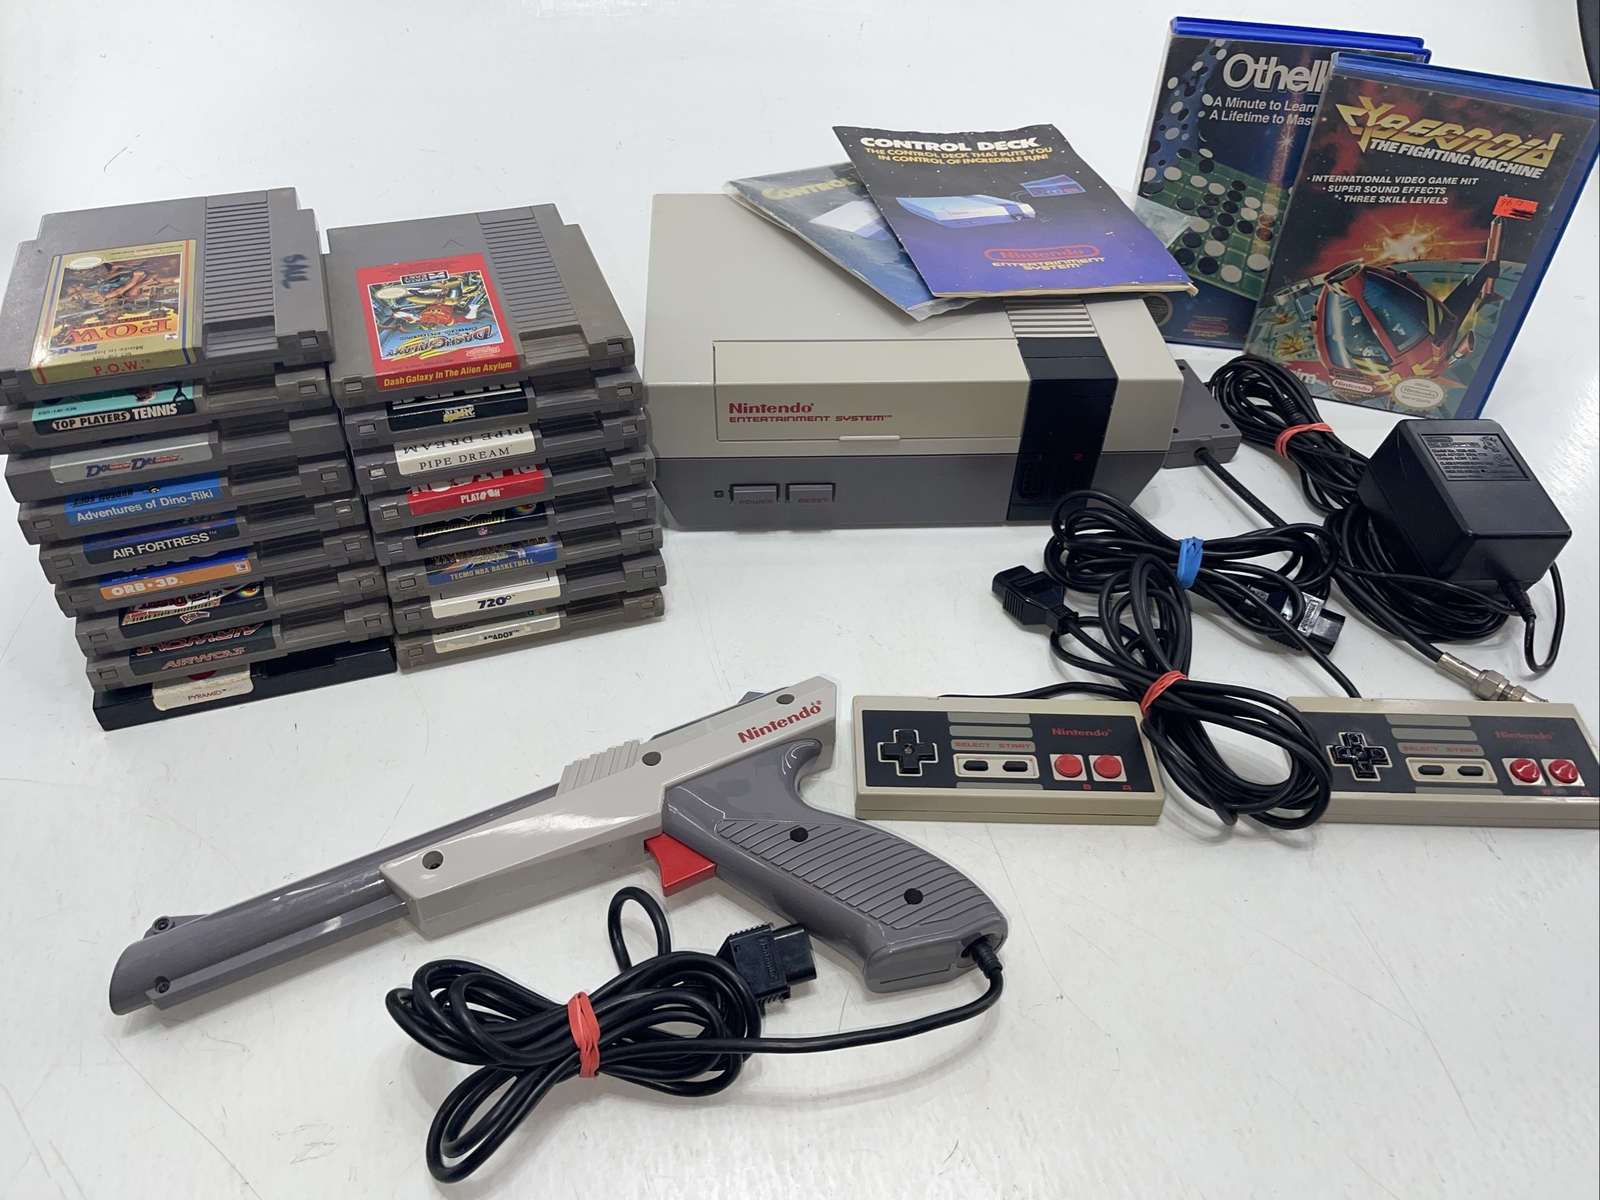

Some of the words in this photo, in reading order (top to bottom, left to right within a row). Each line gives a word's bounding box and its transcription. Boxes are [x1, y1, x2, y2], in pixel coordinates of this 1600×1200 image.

[1222, 53, 1329, 93] Othell
[1212, 96, 1222, 107] A
[1225, 97, 1266, 109] Minute
[1269, 101, 1282, 111] to
[1209, 110, 1218, 121] A
[1221, 110, 1269, 123] Lifetime
[1272, 114, 1284, 125] to
[1286, 113, 1314, 126] Mas
[860, 137, 972, 152] CONTROL
[977, 137, 1040, 151] DECK
[864, 147, 886, 156] THE
[887, 148, 940, 158] CONTROL
[1000, 149, 1027, 158] PUTS
[1028, 146, 1053, 155] YOU
[877, 154, 891, 162] IN
[892, 155, 946, 165] CONTROL
[962, 156, 1023, 164] INCREDIBLE
[1023, 153, 1049, 162] FUN!
[1369, 138, 1400, 154] THE
[1398, 142, 1471, 167] FIGHTING
[1470, 156, 1545, 180] MACHINE
[1311, 174, 1392, 184] INTERNATIONAL
[1395, 176, 1426, 185] VIDEO
[1428, 176, 1458, 185] GAME
[1461, 177, 1479, 186] HIT
[761, 178, 857, 200] CONTROL
[1327, 185, 1362, 193] SUPER
[1364, 185, 1400, 194] SOUND
[1401, 186, 1447, 195] EFFECTS
[1343, 195, 1377, 203] THREE
[1378, 195, 1408, 204] SKILL
[1409, 196, 1449, 205] LEVELS
[1000, 248, 1084, 260] Nintendo
[992, 257, 1105, 268] ENTERTAINMENT
[1023, 263, 1080, 271] SYSTEM
[383, 376, 405, 387] Dash
[406, 372, 434, 385] Galaxy
[435, 370, 444, 379] In
[444, 368, 459, 378] The
[460, 365, 481, 375] Alien
[482, 361, 513, 374] Asylum
[1334, 380, 1371, 392] Nintendo
[1403, 386, 1436, 398] Nintendo
[728, 402, 813, 414] Nintendo
[54, 420, 76, 430] TOP
[80, 412, 127, 426] PLAYERS
[132, 403, 178, 420] TENNIS
[729, 415, 830, 423] ENTERTAINMENT
[480, 427, 525, 441] PIPE
[402, 435, 474, 454] DREAM
[419, 456, 453, 470] PIPE
[458, 446, 510, 464] DREAM
[76, 504, 143, 523] Adventures
[145, 500, 158, 510] of
[160, 489, 214, 507] Dino-Riki
[113, 546, 135, 560] AIR
[449, 570, 474, 581] TECMO
[475, 568, 490, 577] NBA
[491, 559, 535, 573] BASKETBALL
[161, 645, 247, 671] AIRWOLF
[187, 689, 223, 701] PYRAMID
[737, 705, 822, 744] Nintendo
[1051, 727, 1109, 737] Nintendo
[1494, 730, 1552, 741] Nintendo
[1446, 746, 1479, 754] START
